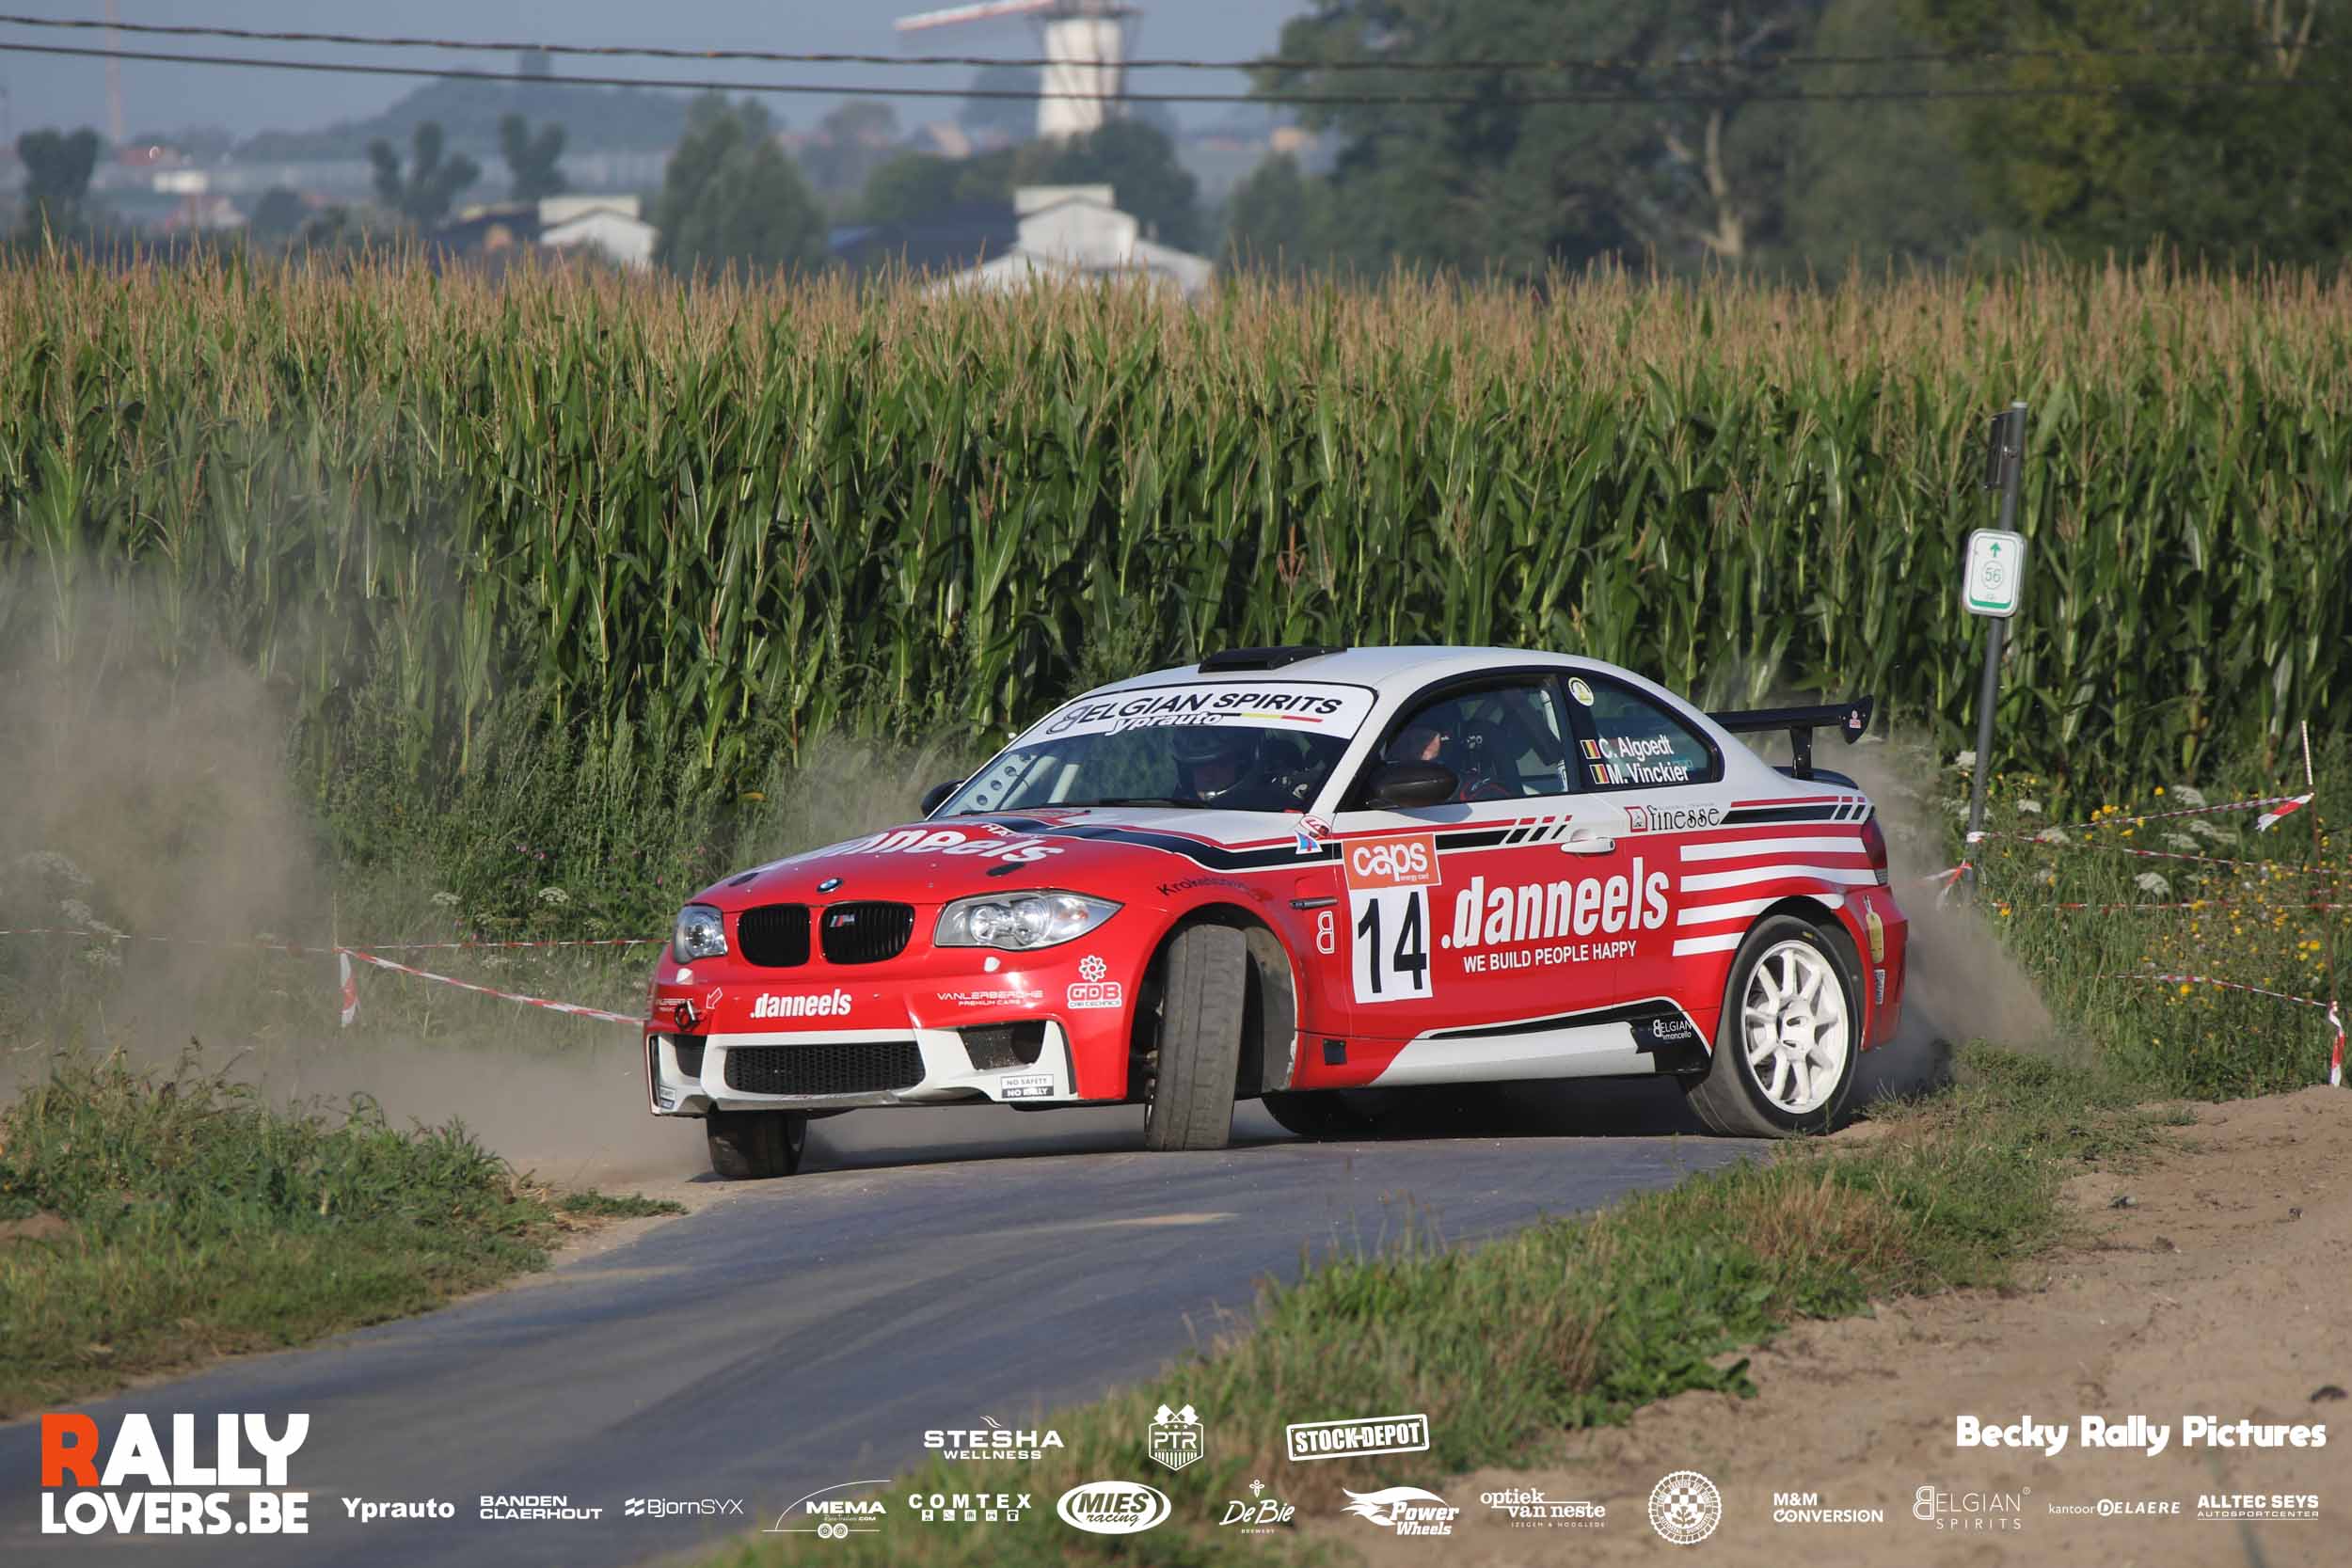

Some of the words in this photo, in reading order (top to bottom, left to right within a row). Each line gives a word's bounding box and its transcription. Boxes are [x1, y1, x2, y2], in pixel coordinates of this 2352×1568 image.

[1213, 692, 1343, 715] SPIRITS
[1598, 737, 1617, 759] C.
[1618, 735, 1675, 762] Algoedt
[1607, 764, 1629, 785] M.
[1627, 760, 1690, 784] Vinckier
[1647, 805, 1720, 831] finesse
[1353, 843, 1428, 882] caps
[1441, 857, 1670, 949] .danneels
[1358, 892, 1427, 994] 14
[1463, 956, 1486, 974] WE
[1490, 950, 1532, 970] BUILD
[1535, 944, 1589, 966] PEOPLE
[1593, 941, 1637, 960] HAPPY
